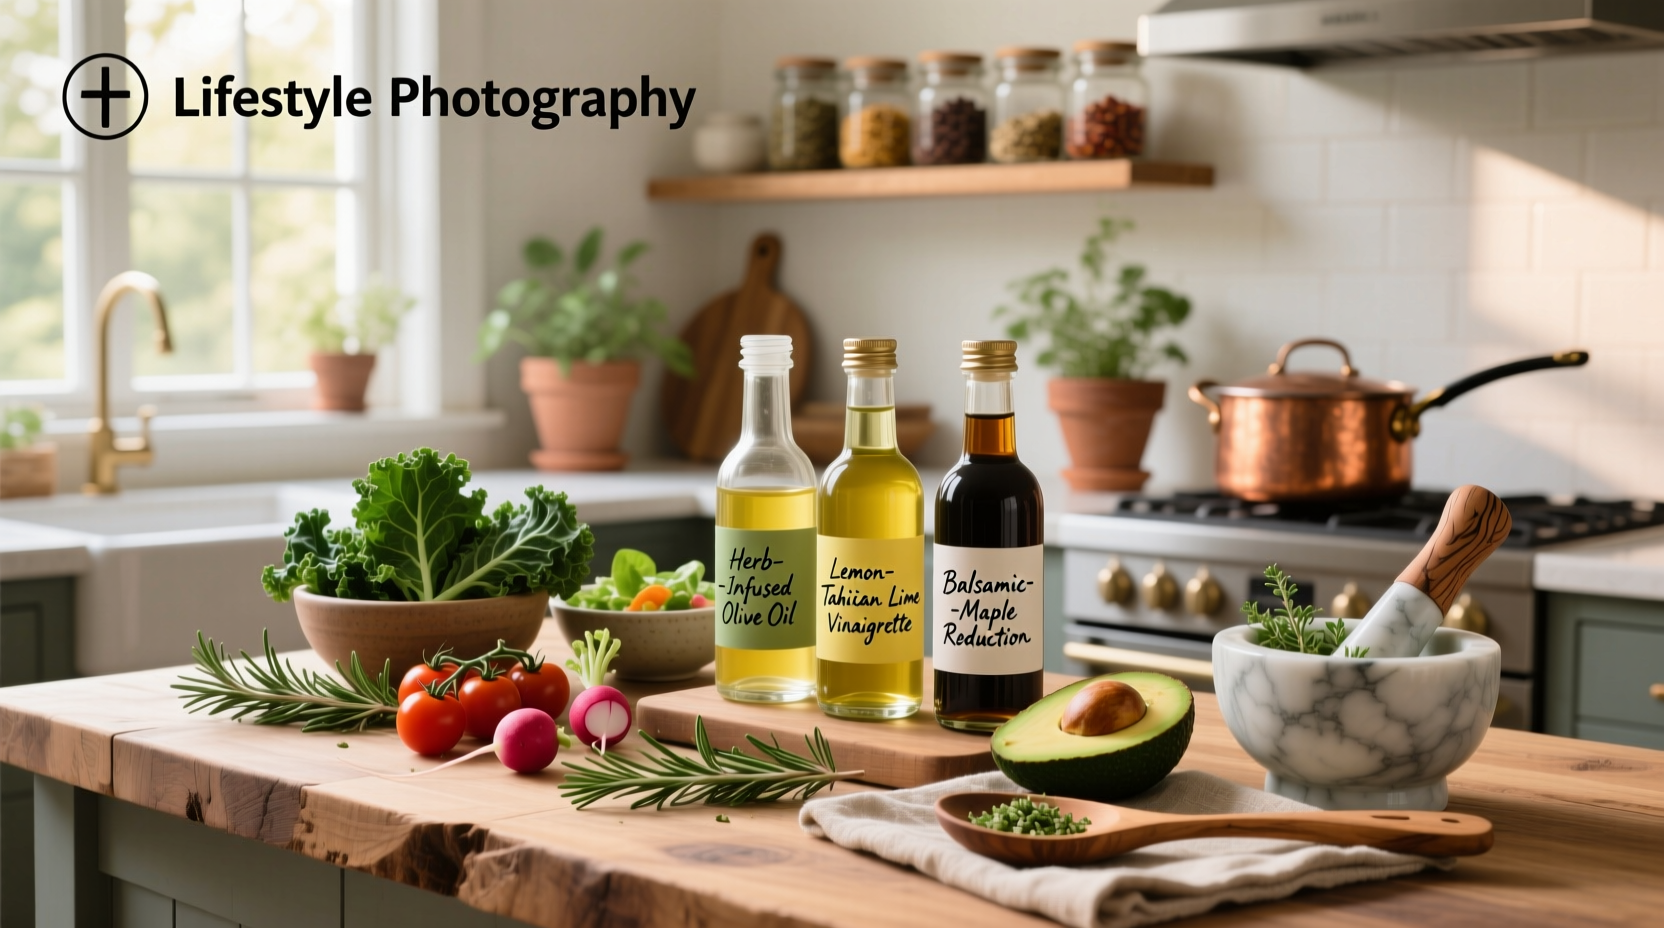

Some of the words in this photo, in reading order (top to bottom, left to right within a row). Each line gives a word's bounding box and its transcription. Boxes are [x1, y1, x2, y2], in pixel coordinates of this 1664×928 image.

[729, 546, 784, 571] Herb-
[829, 557, 895, 581] Lemon-
[942, 569, 1034, 595] Balsamic-
[888, 585, 921, 608] Lime
[722, 600, 763, 626] Olive
[767, 599, 798, 627] Oil
[828, 612, 913, 646] Vinaigrette
[942, 623, 1032, 648] Reduction
